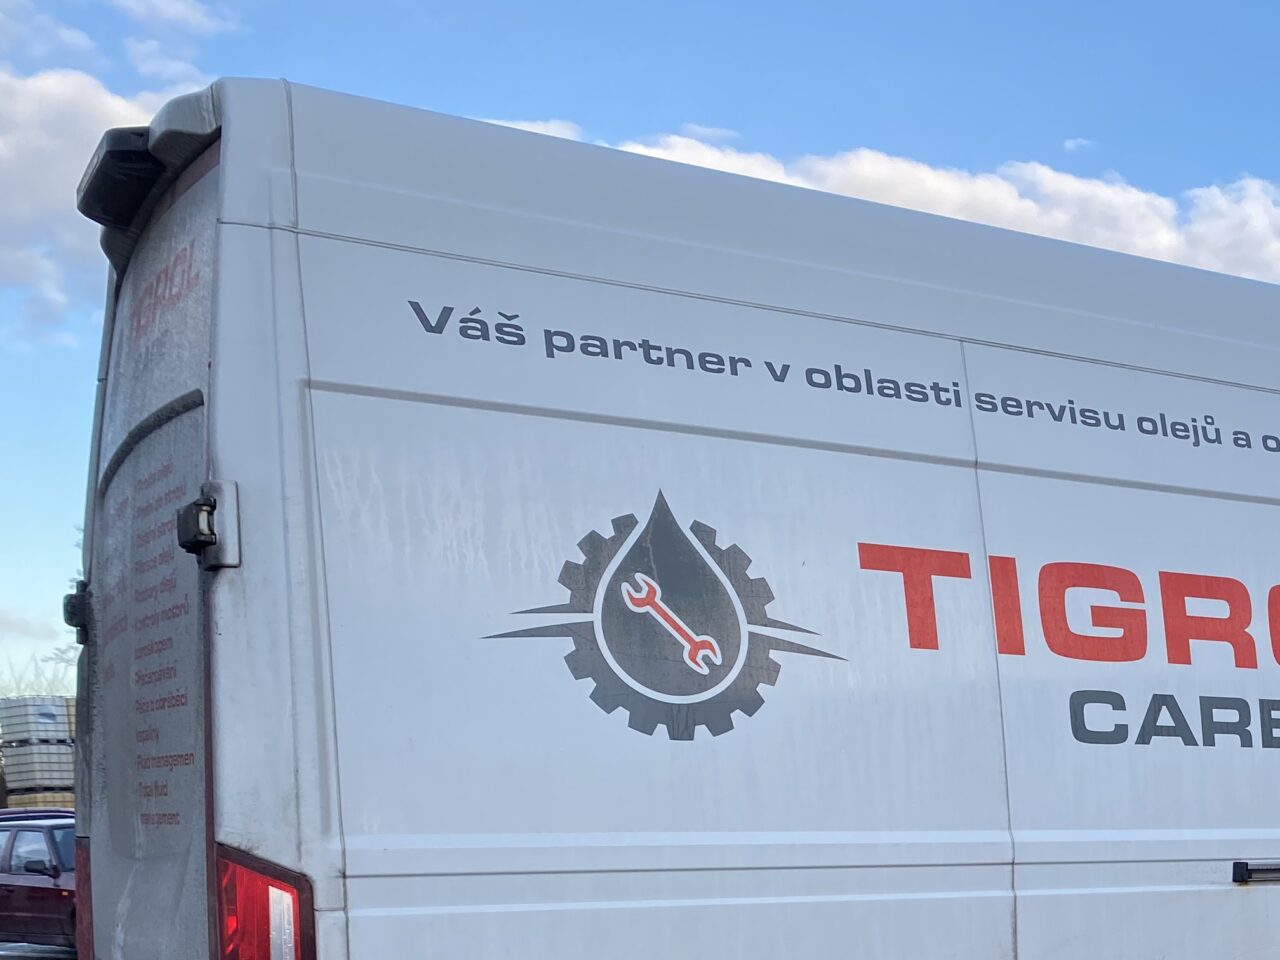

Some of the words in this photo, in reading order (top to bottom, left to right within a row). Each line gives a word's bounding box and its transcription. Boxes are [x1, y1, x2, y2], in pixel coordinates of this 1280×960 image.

[409, 301, 526, 346] Váš
[543, 327, 752, 376] partner
[764, 360, 791, 384] v
[805, 364, 963, 408] oblasti
[974, 391, 1126, 432] servisu
[1136, 412, 1224, 448] olejů
[1232, 427, 1253, 449] a
